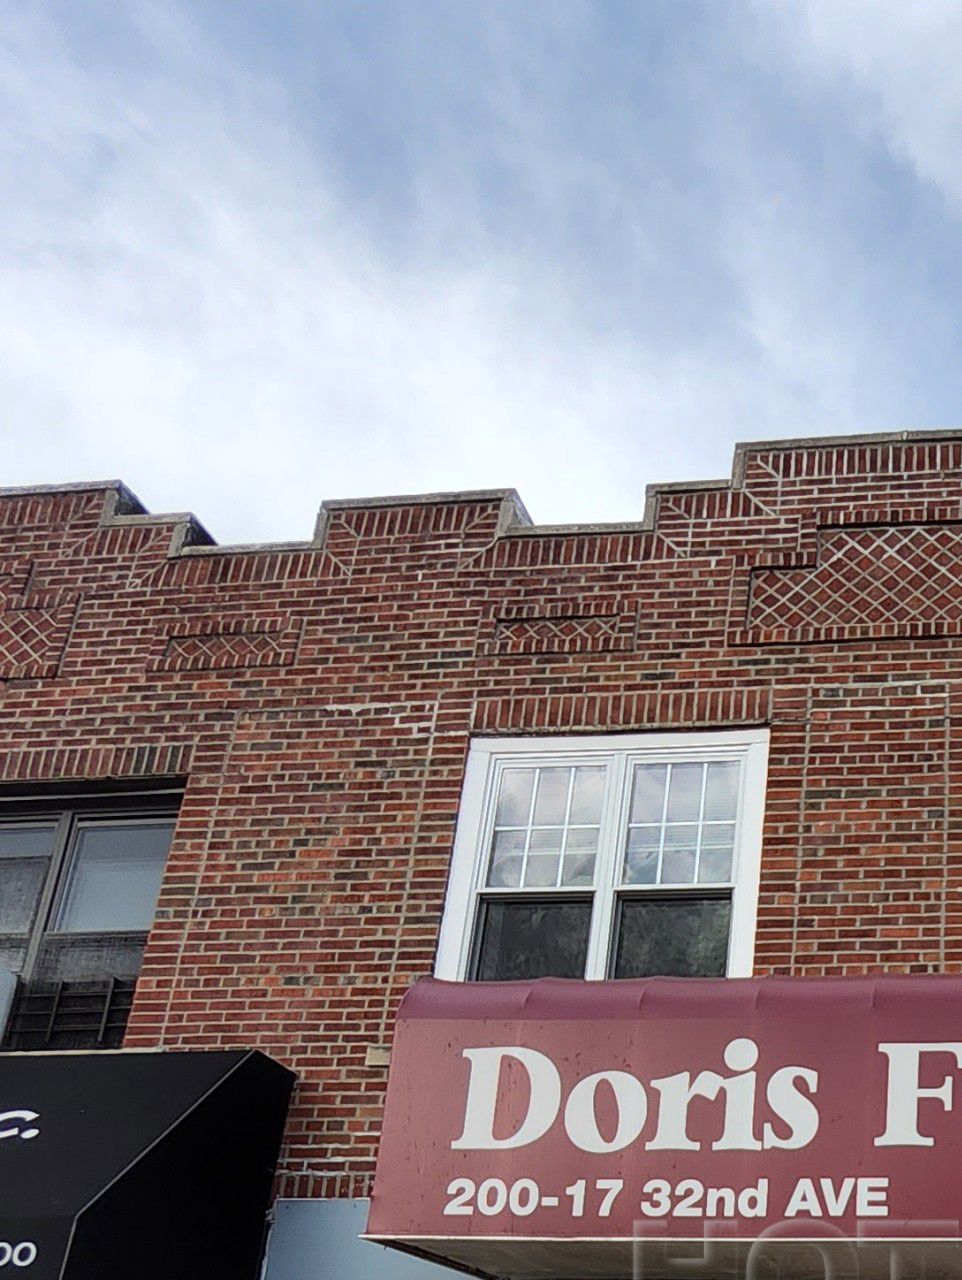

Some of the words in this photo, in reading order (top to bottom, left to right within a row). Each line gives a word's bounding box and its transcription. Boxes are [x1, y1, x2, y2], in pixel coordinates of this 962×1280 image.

[451, 1037, 820, 1154] Doris
[443, 1177, 625, 1218] 200-17
[640, 1177, 769, 1218] 32nd
[784, 1177, 890, 1217] AVE
